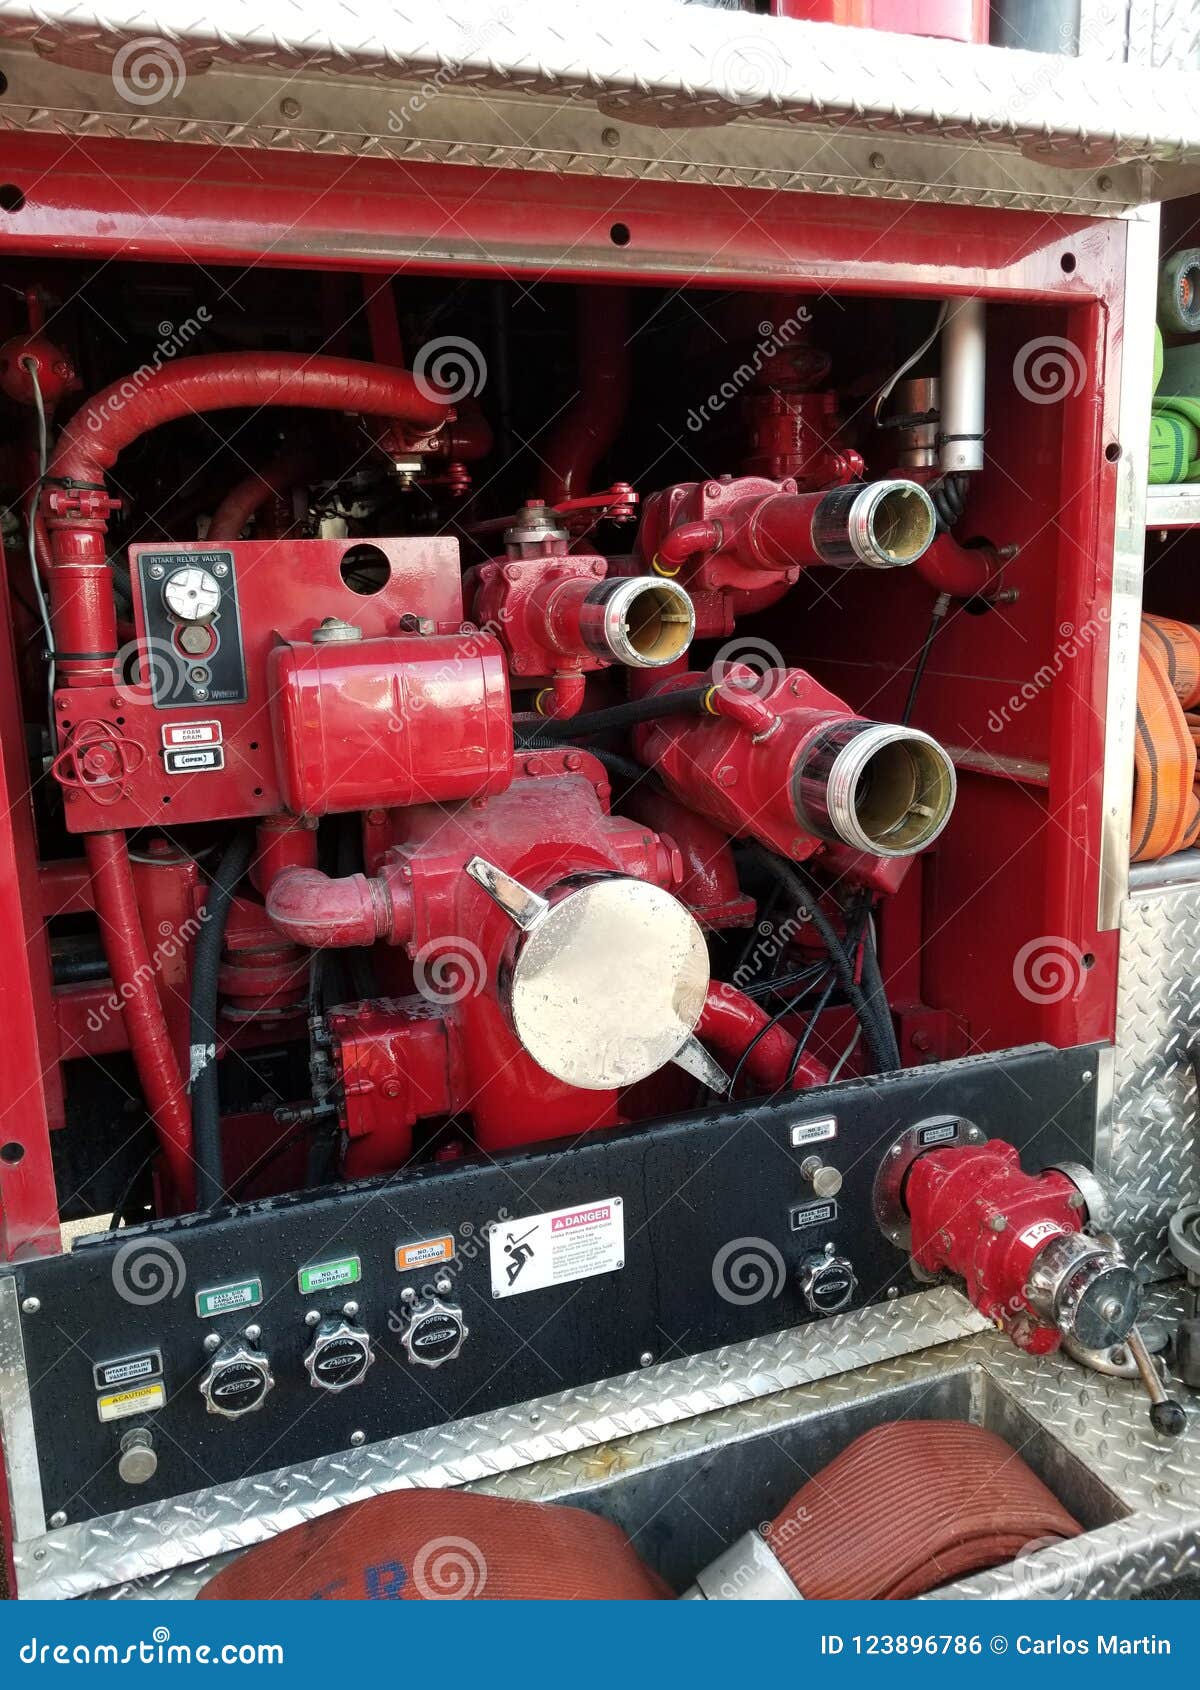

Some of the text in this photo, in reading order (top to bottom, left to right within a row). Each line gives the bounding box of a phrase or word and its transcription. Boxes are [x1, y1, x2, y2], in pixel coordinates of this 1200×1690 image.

[151, 556, 174, 564] INTAKE
[565, 1209, 609, 1226] DANGER
[1025, 1222, 1058, 1241] T-20
[407, 1250, 444, 1262] DISCHARGE
[311, 1272, 349, 1286] DISCHARGE
[425, 1315, 442, 1325] OPEN
[330, 1339, 348, 1348] OPEN
[105, 1361, 150, 1375] INTAKE RELIEF
[226, 1364, 245, 1373] OPEN
[118, 1388, 152, 1402] CAUTION
